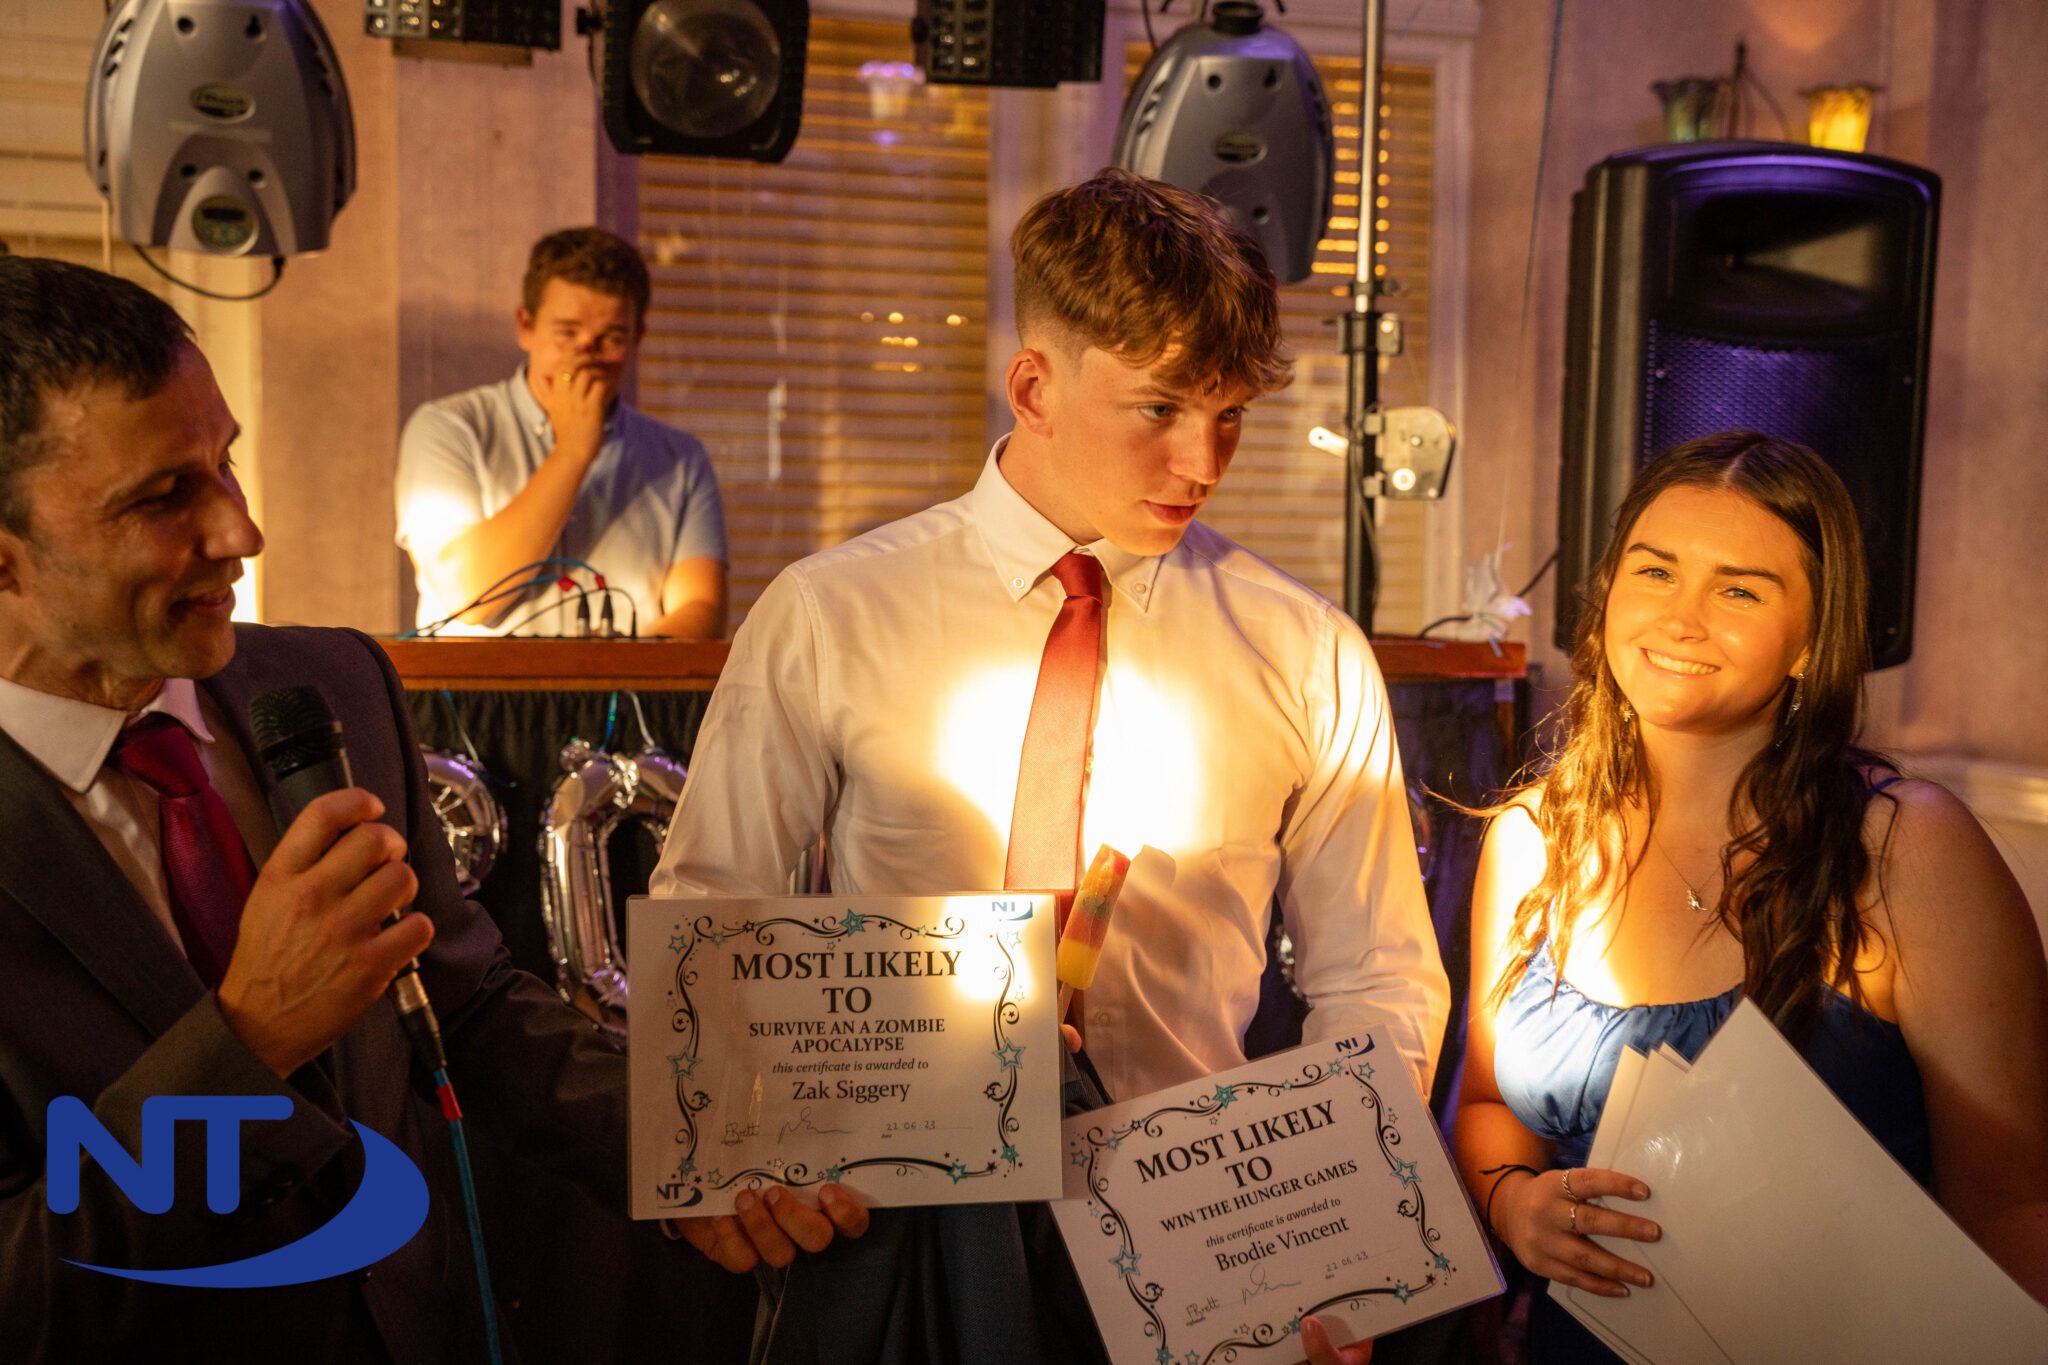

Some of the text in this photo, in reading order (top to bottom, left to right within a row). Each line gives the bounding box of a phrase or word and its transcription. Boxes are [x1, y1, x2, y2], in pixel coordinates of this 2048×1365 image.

[731, 950, 962, 980] MOST LIKELY
[822, 986, 872, 1014] TO
[750, 1018, 945, 1037] SURVIVE AN A ZOMBIE
[791, 1037, 905, 1053] APOCALYPSE
[772, 1058, 929, 1075] this certificate is awarded to
[791, 1080, 911, 1104] Zak Siggery
[1133, 1100, 1336, 1184] MOST LIKELY
[1224, 1156, 1273, 1189] TO
[1160, 1160, 1358, 1233] WIN THE HUNGER GAMES
[1206, 1198, 1341, 1248] this certificate is awarded to
[1215, 1216, 1350, 1272] Brodie Vincent
